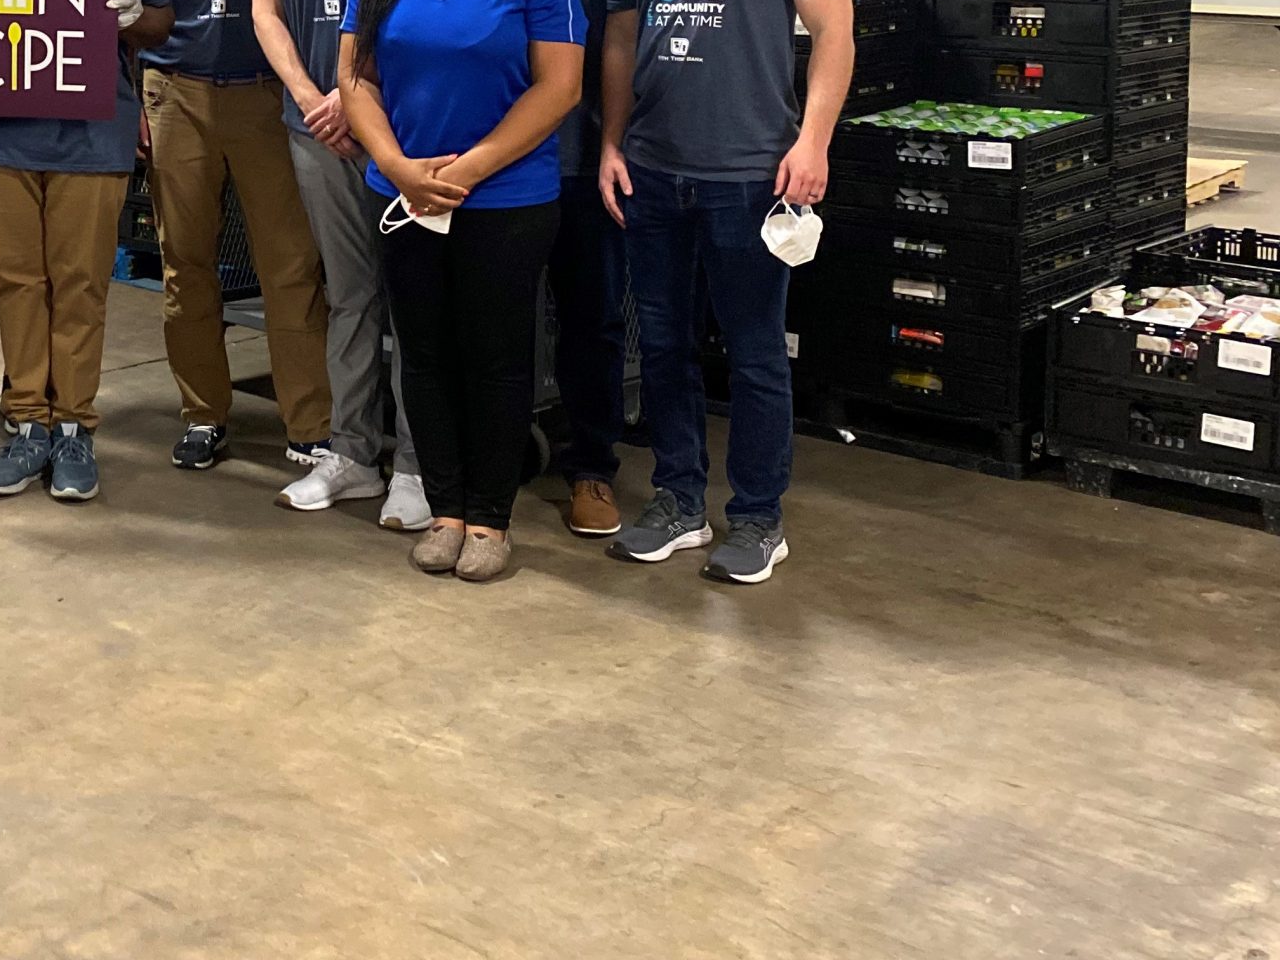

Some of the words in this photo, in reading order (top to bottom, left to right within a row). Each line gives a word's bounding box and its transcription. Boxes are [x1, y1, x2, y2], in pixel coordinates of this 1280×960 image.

[655, 3, 725, 13] COMMUNITY
[655, 15, 671, 27] AT
[674, 15, 685, 26] A
[690, 15, 723, 28] TIME
